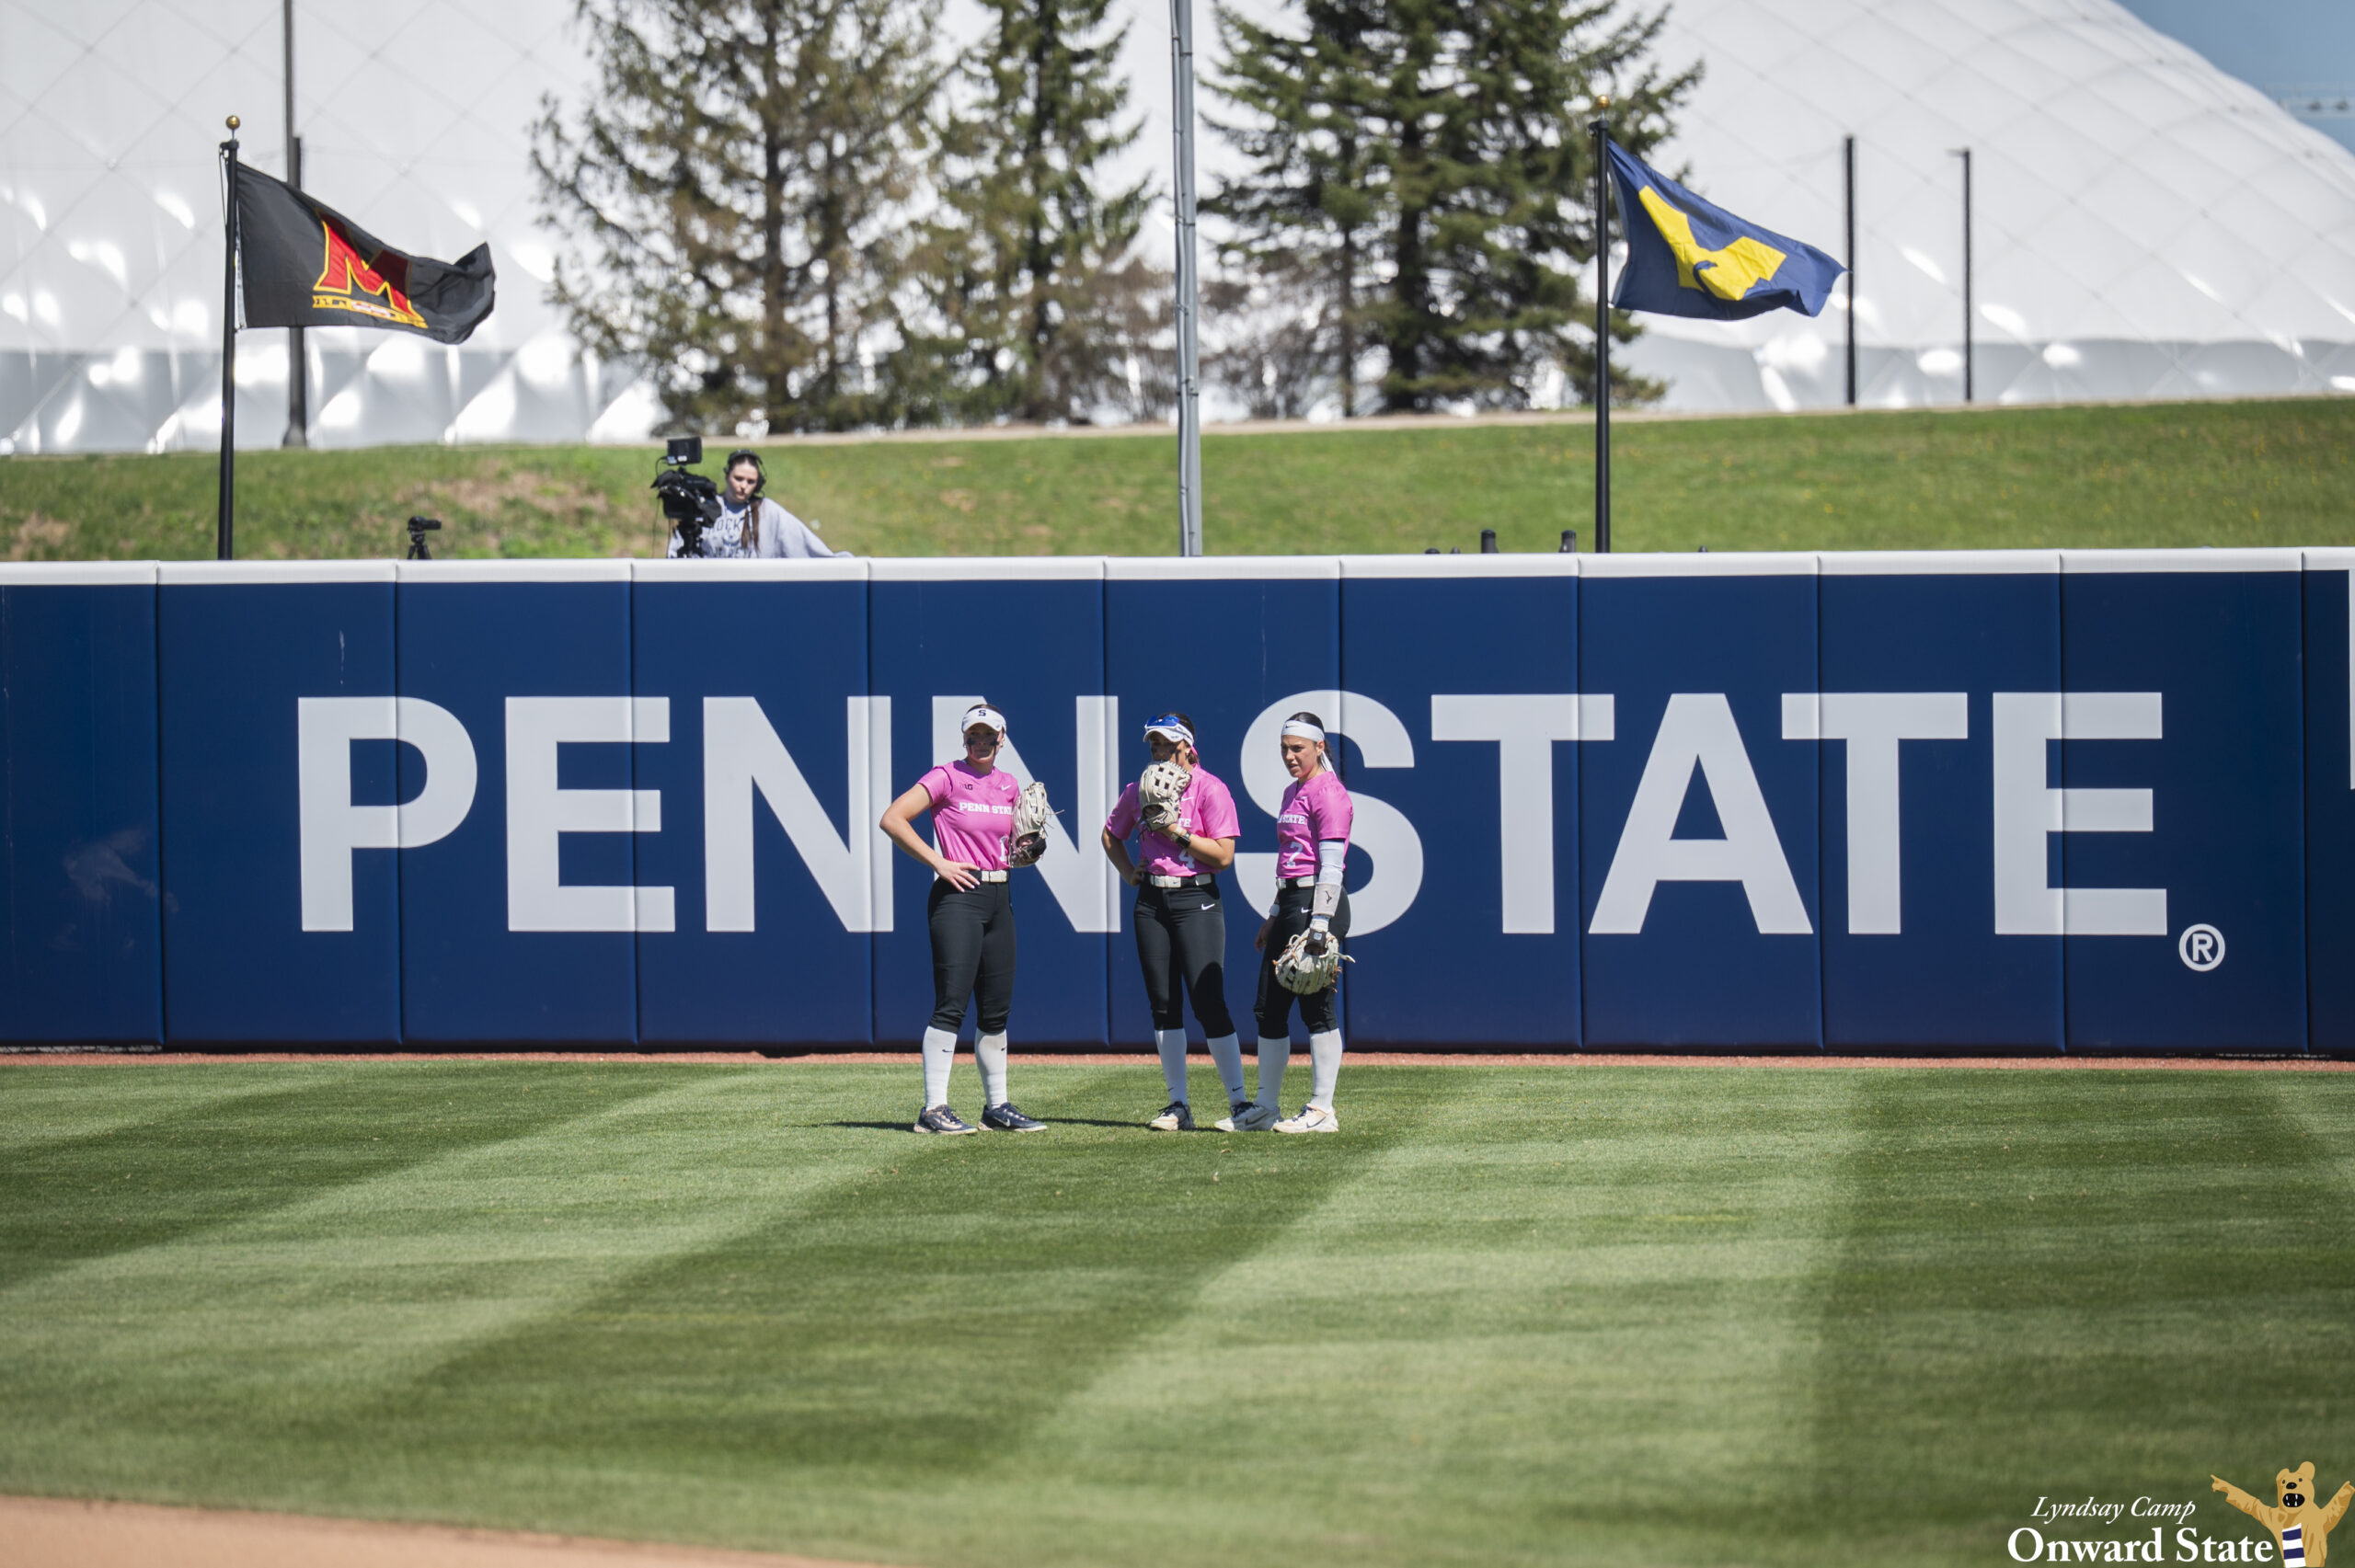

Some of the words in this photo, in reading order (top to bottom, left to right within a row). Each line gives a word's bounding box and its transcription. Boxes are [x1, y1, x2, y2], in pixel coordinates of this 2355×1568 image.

[313, 207, 425, 322] M
[298, 693, 1121, 935] PENN
[1234, 690, 2168, 938] STATE
[959, 802, 990, 814] PENN
[992, 805, 1013, 816] STA
